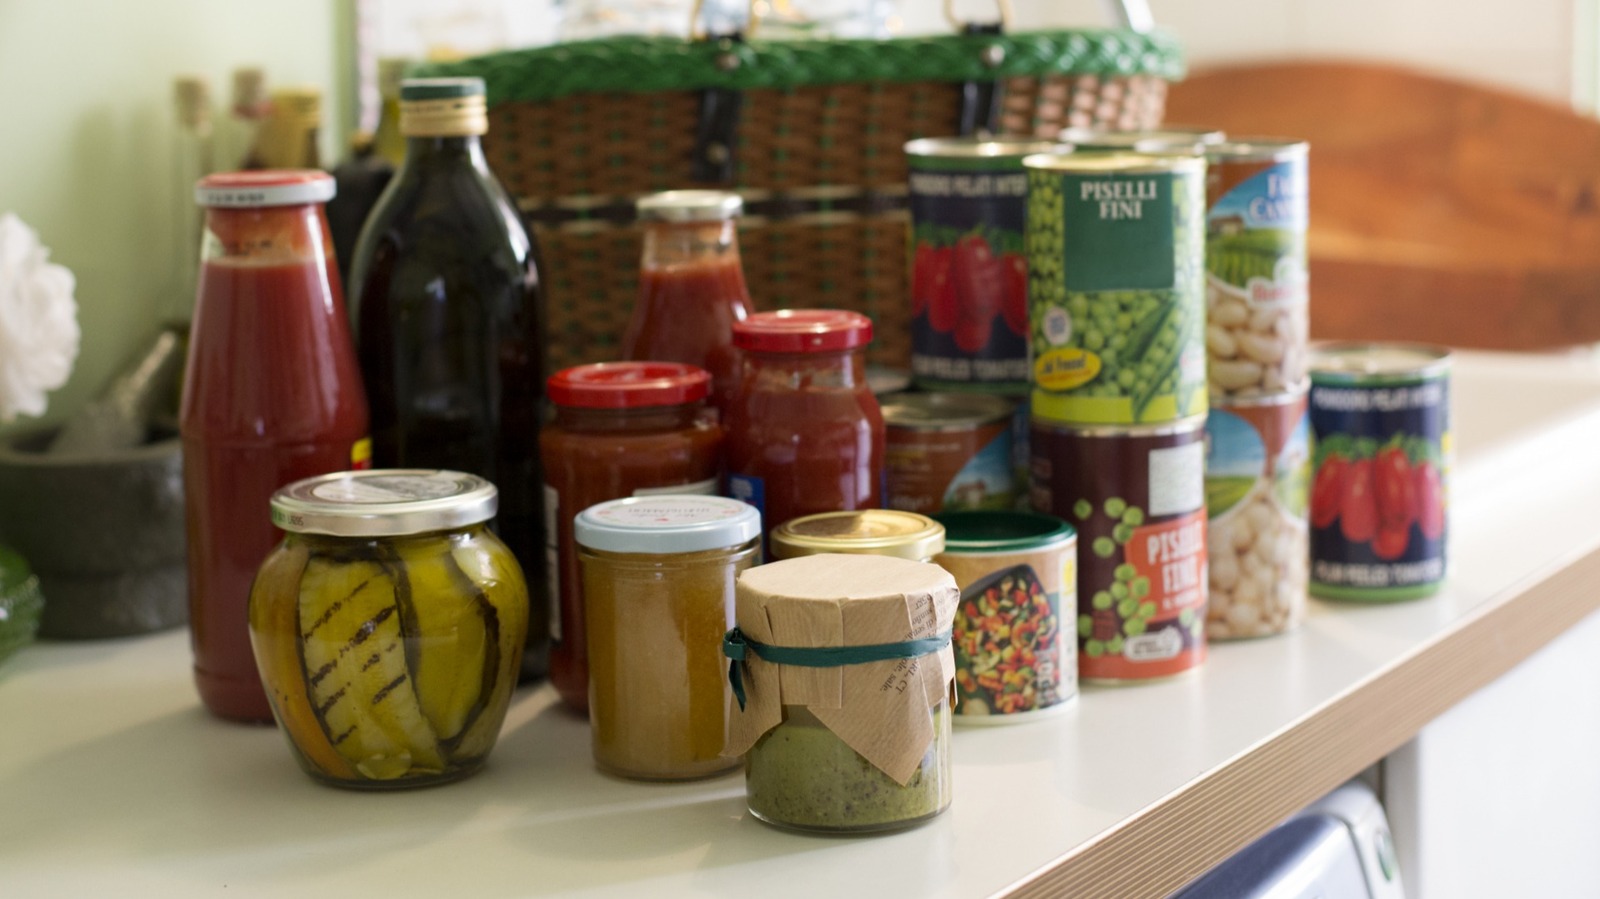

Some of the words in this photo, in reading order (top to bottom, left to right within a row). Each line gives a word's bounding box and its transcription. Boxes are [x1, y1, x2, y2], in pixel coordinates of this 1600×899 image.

[1081, 181, 1157, 200] PISELLI
[1100, 200, 1142, 219] FINI
[880, 673, 896, 692] sale.
[895, 680, 908, 695] CT
